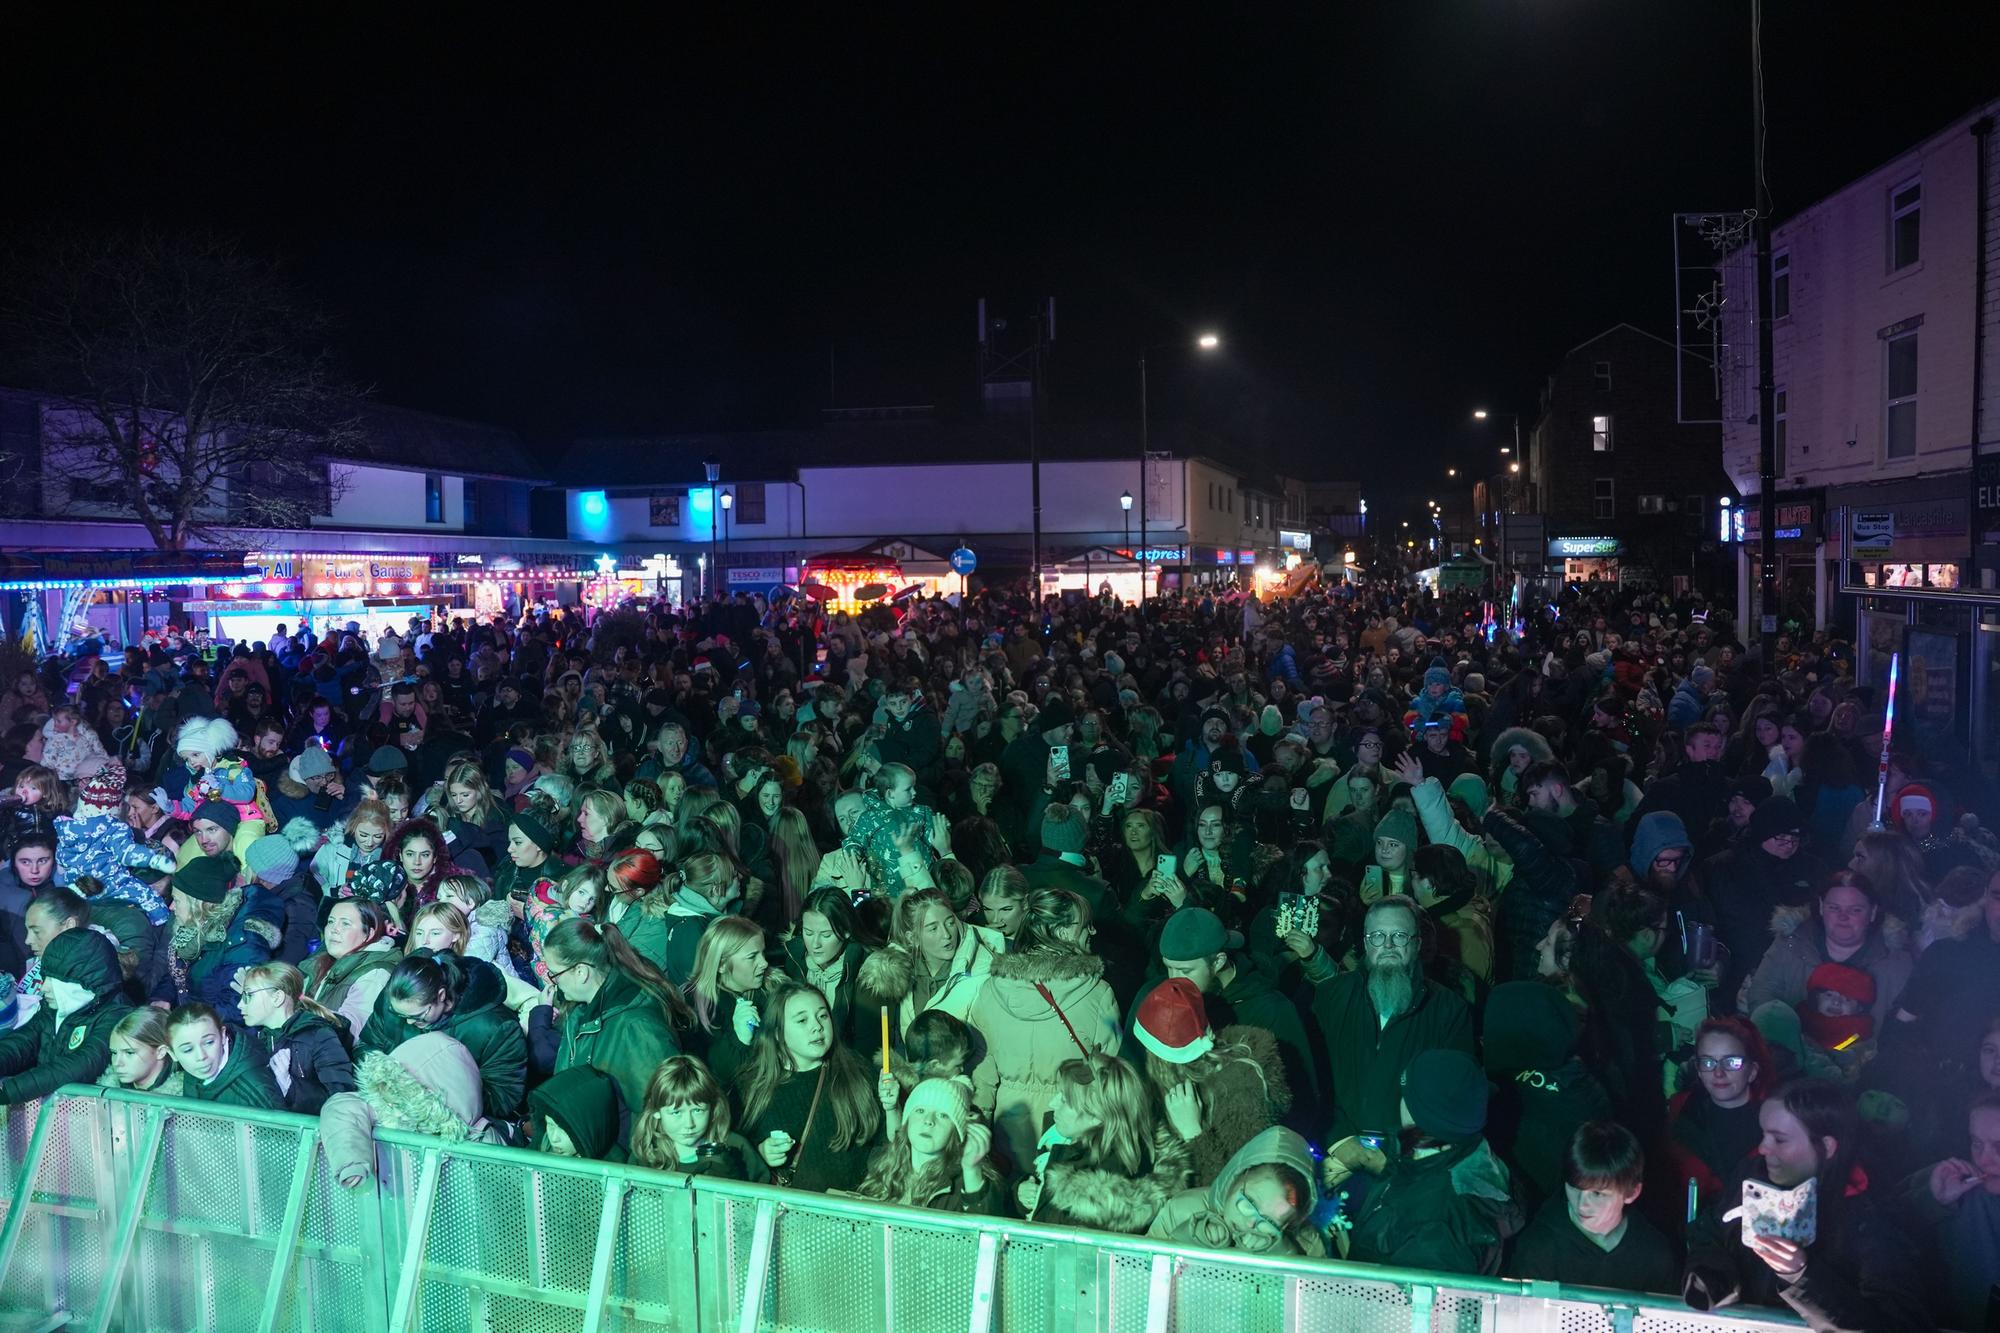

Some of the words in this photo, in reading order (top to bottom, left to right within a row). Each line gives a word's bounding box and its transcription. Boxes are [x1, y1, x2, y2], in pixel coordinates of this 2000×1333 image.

[1135, 548, 1186, 563] express
[273, 562, 292, 578] All
[326, 562, 351, 577] Fun
[356, 568, 364, 577] &
[370, 562, 413, 578] Games
[732, 571, 760, 579] TESCO
